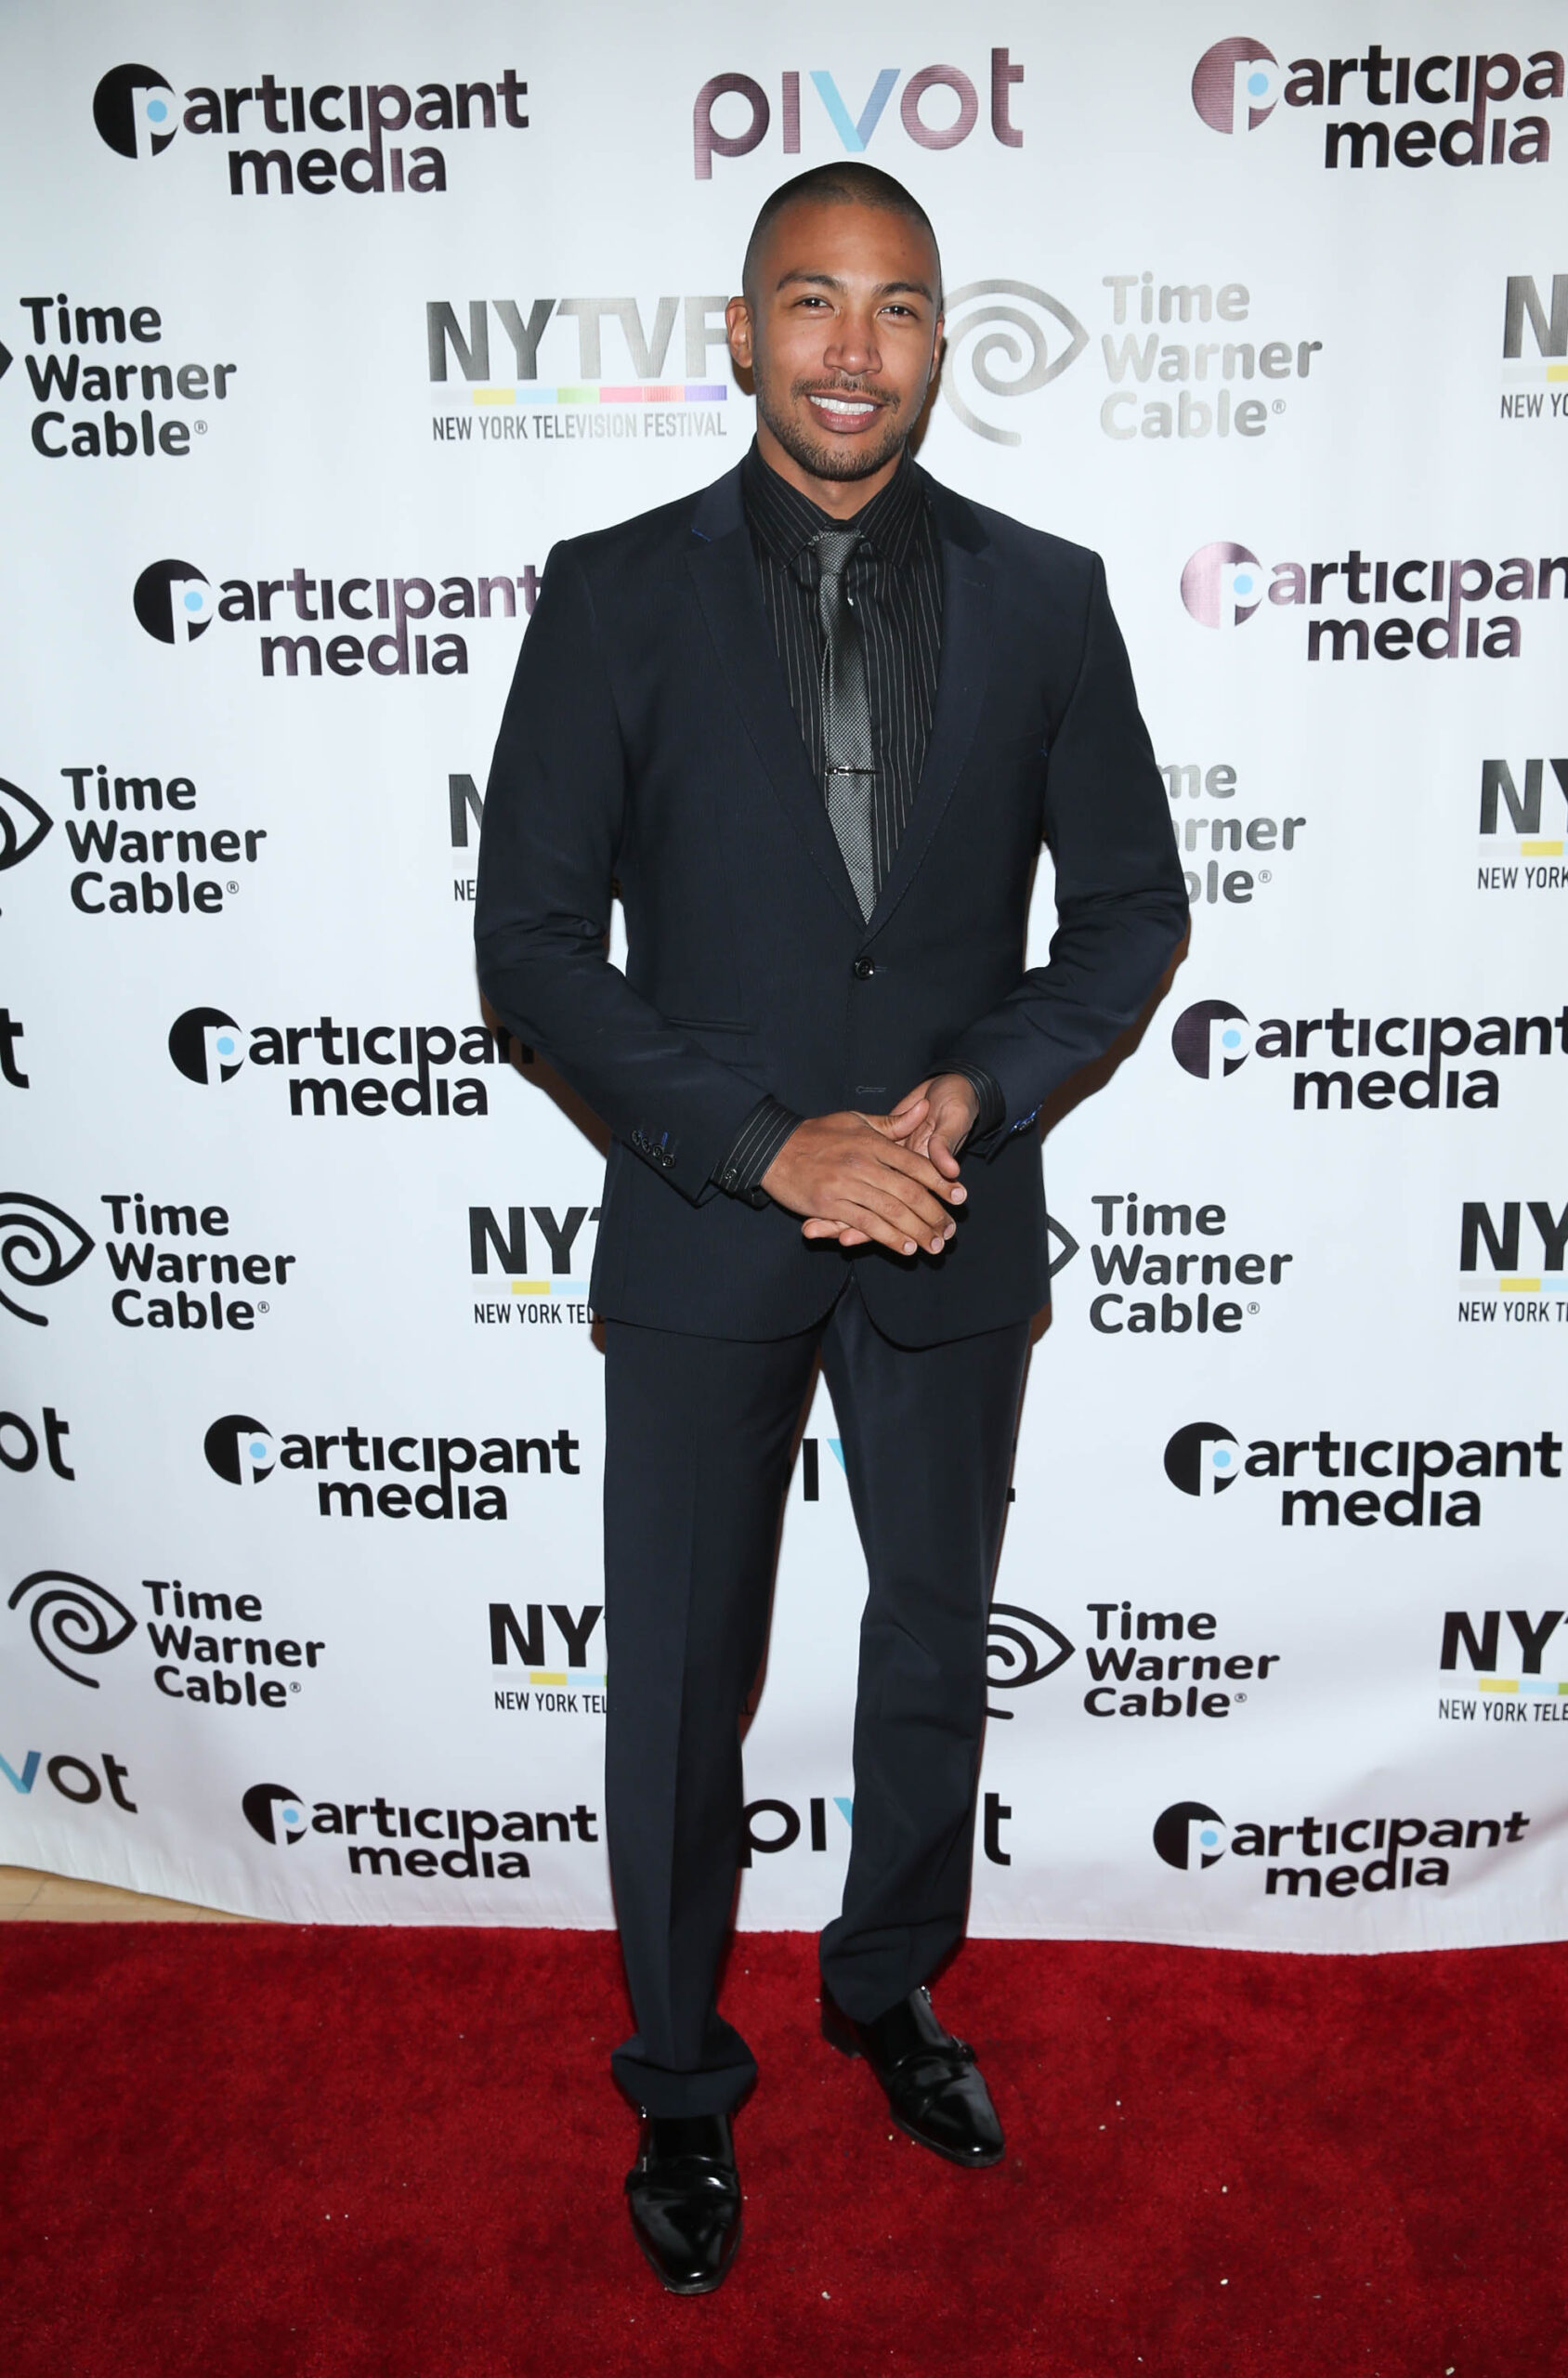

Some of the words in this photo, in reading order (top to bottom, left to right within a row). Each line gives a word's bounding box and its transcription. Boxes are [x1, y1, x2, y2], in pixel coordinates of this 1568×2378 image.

[1192, 36, 1568, 135] participa
[693, 47, 1025, 179] pivot
[1325, 116, 1550, 168] media
[229, 146, 447, 196] media
[20, 293, 163, 345] Time
[1100, 271, 1248, 325] Time
[426, 296, 729, 382] NYTVF
[1100, 333, 1323, 384] Warner
[24, 354, 237, 402] Warner
[432, 416, 474, 441] NEW
[479, 415, 529, 440] YORK
[532, 413, 638, 440] TELEVISION
[643, 412, 727, 438] FESTIVAL
[1501, 394, 1544, 419] NEW
[260, 633, 468, 677] media
[1307, 615, 1521, 661] media
[60, 764, 197, 811] Time
[65, 819, 268, 863] Warner
[454, 880, 476, 901] NE
[1478, 867, 1519, 889] NEW
[289, 1077, 489, 1117] media
[1293, 1069, 1499, 1110] media
[101, 1194, 229, 1236] Time
[1091, 1193, 1226, 1236] Time
[106, 1242, 296, 1285] Warner
[1091, 1244, 1293, 1286] Warner
[474, 1303, 512, 1325] NEW
[516, 1303, 563, 1325] YORK
[1458, 1301, 1497, 1323] NEW
[1503, 1301, 1549, 1323] YORK
[318, 1482, 508, 1521] media
[1281, 1487, 1482, 1527] media
[142, 1579, 263, 1623] Time
[1086, 1601, 1218, 1641] Time
[147, 1623, 325, 1668] Warner
[1086, 1647, 1280, 1681] Warner
[494, 1692, 529, 1710] NEW
[535, 1692, 578, 1713] YORK
[1439, 1699, 1477, 1720] NEW
[1483, 1701, 1527, 1722] YORK
[347, 1846, 531, 1880] media
[1264, 1856, 1450, 1898] media
